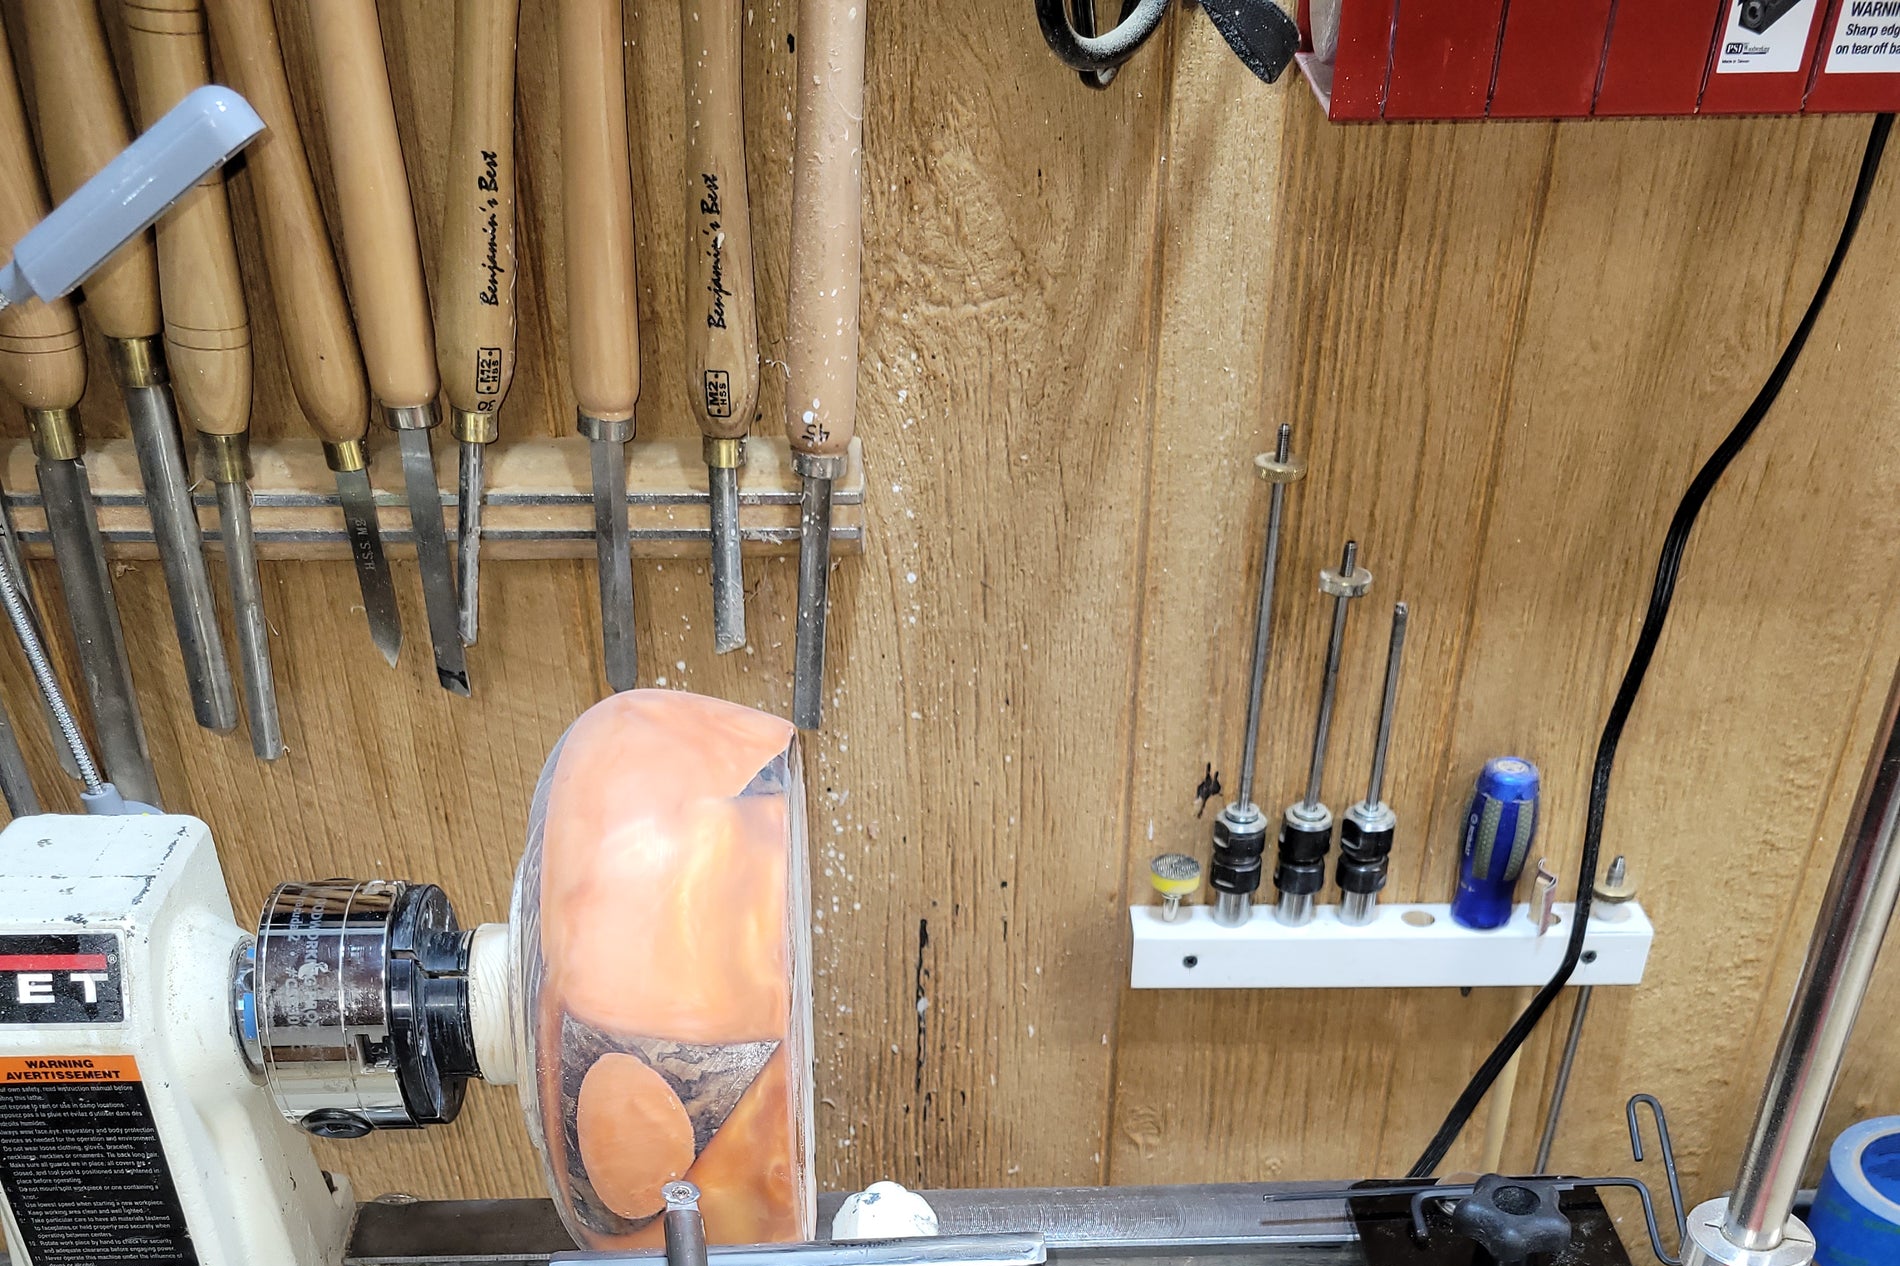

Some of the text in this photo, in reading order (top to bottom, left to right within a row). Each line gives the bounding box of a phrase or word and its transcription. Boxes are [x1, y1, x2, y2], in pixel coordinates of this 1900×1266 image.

[1846, 23, 1878, 38] Sharp
[1836, 45, 1849, 55] on
[1852, 42, 1873, 55] tear
[1873, 42, 1889, 55] off
[478, 150, 505, 307] Benjamin's Best
[700, 174, 732, 330] Benjamin's Best
[480, 358, 491, 384] M2
[708, 381, 719, 406] M2
[719, 383, 727, 405] HSS
[355, 519, 369, 535] M2
[25, 1059, 94, 1069] WARNING
[6, 1070, 120, 1081] AVERTISSEMENT
